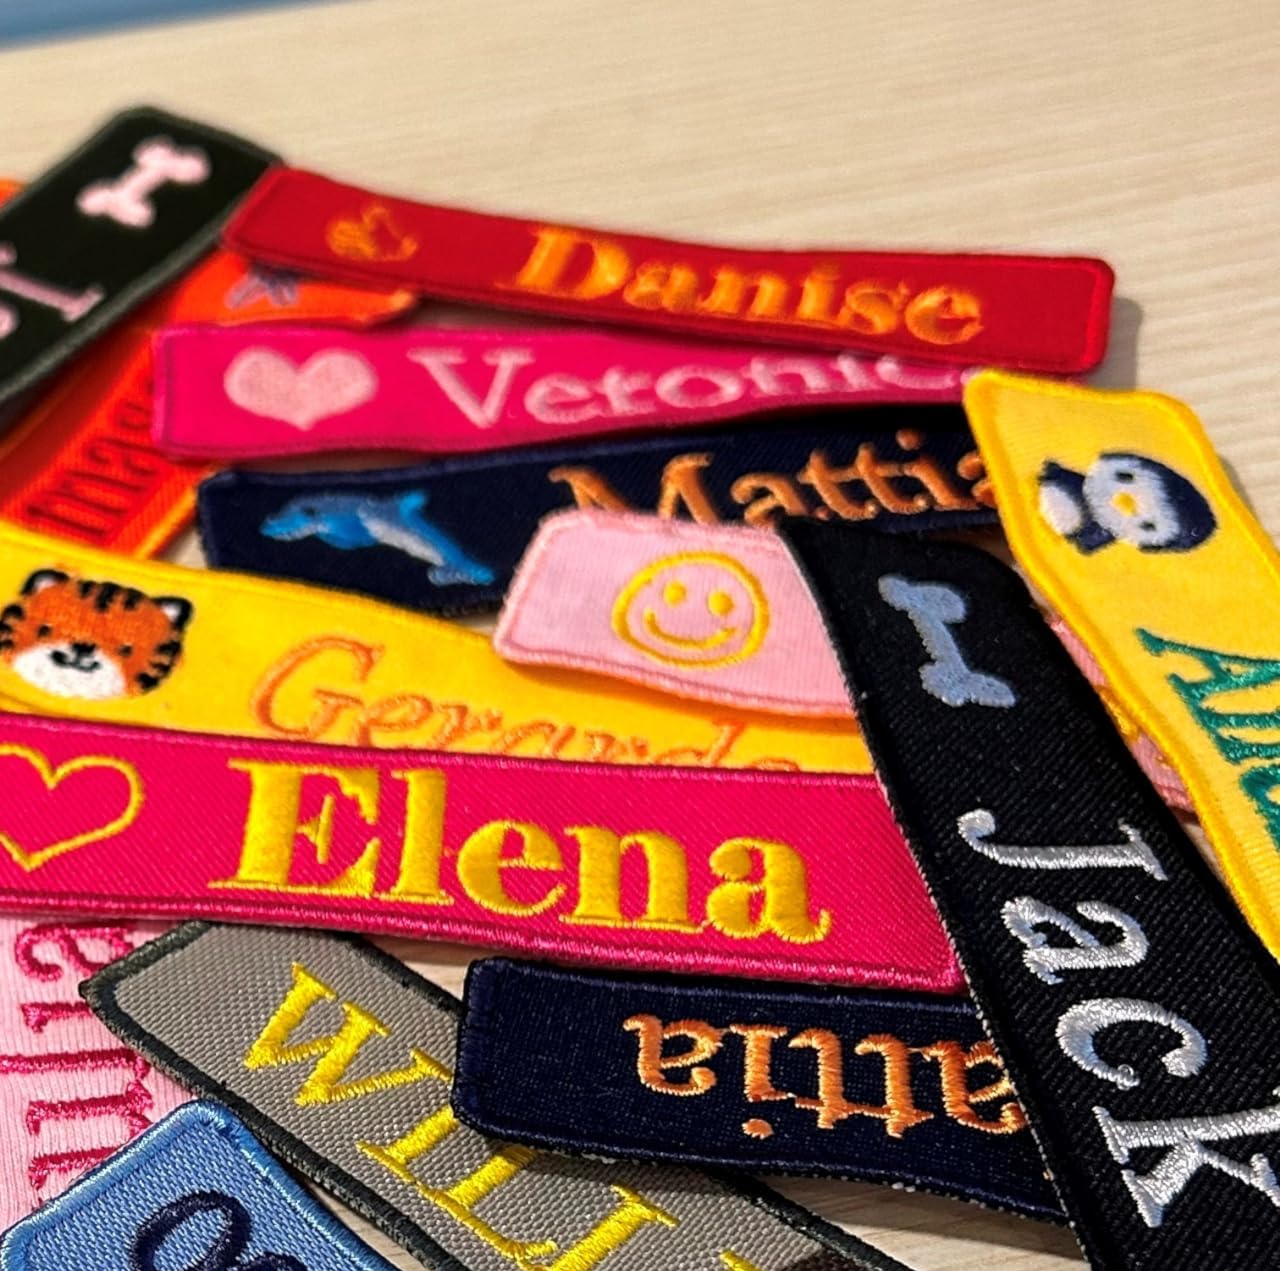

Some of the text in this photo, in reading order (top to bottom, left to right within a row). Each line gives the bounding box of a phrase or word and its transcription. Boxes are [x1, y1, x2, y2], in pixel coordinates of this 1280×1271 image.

[495, 227, 984, 346] Danise
[408, 350, 982, 427] Veronic
[207, 758, 832, 944] Elena
[622, 1012, 1028, 1138] attia
[956, 807, 1280, 1230] Jack
